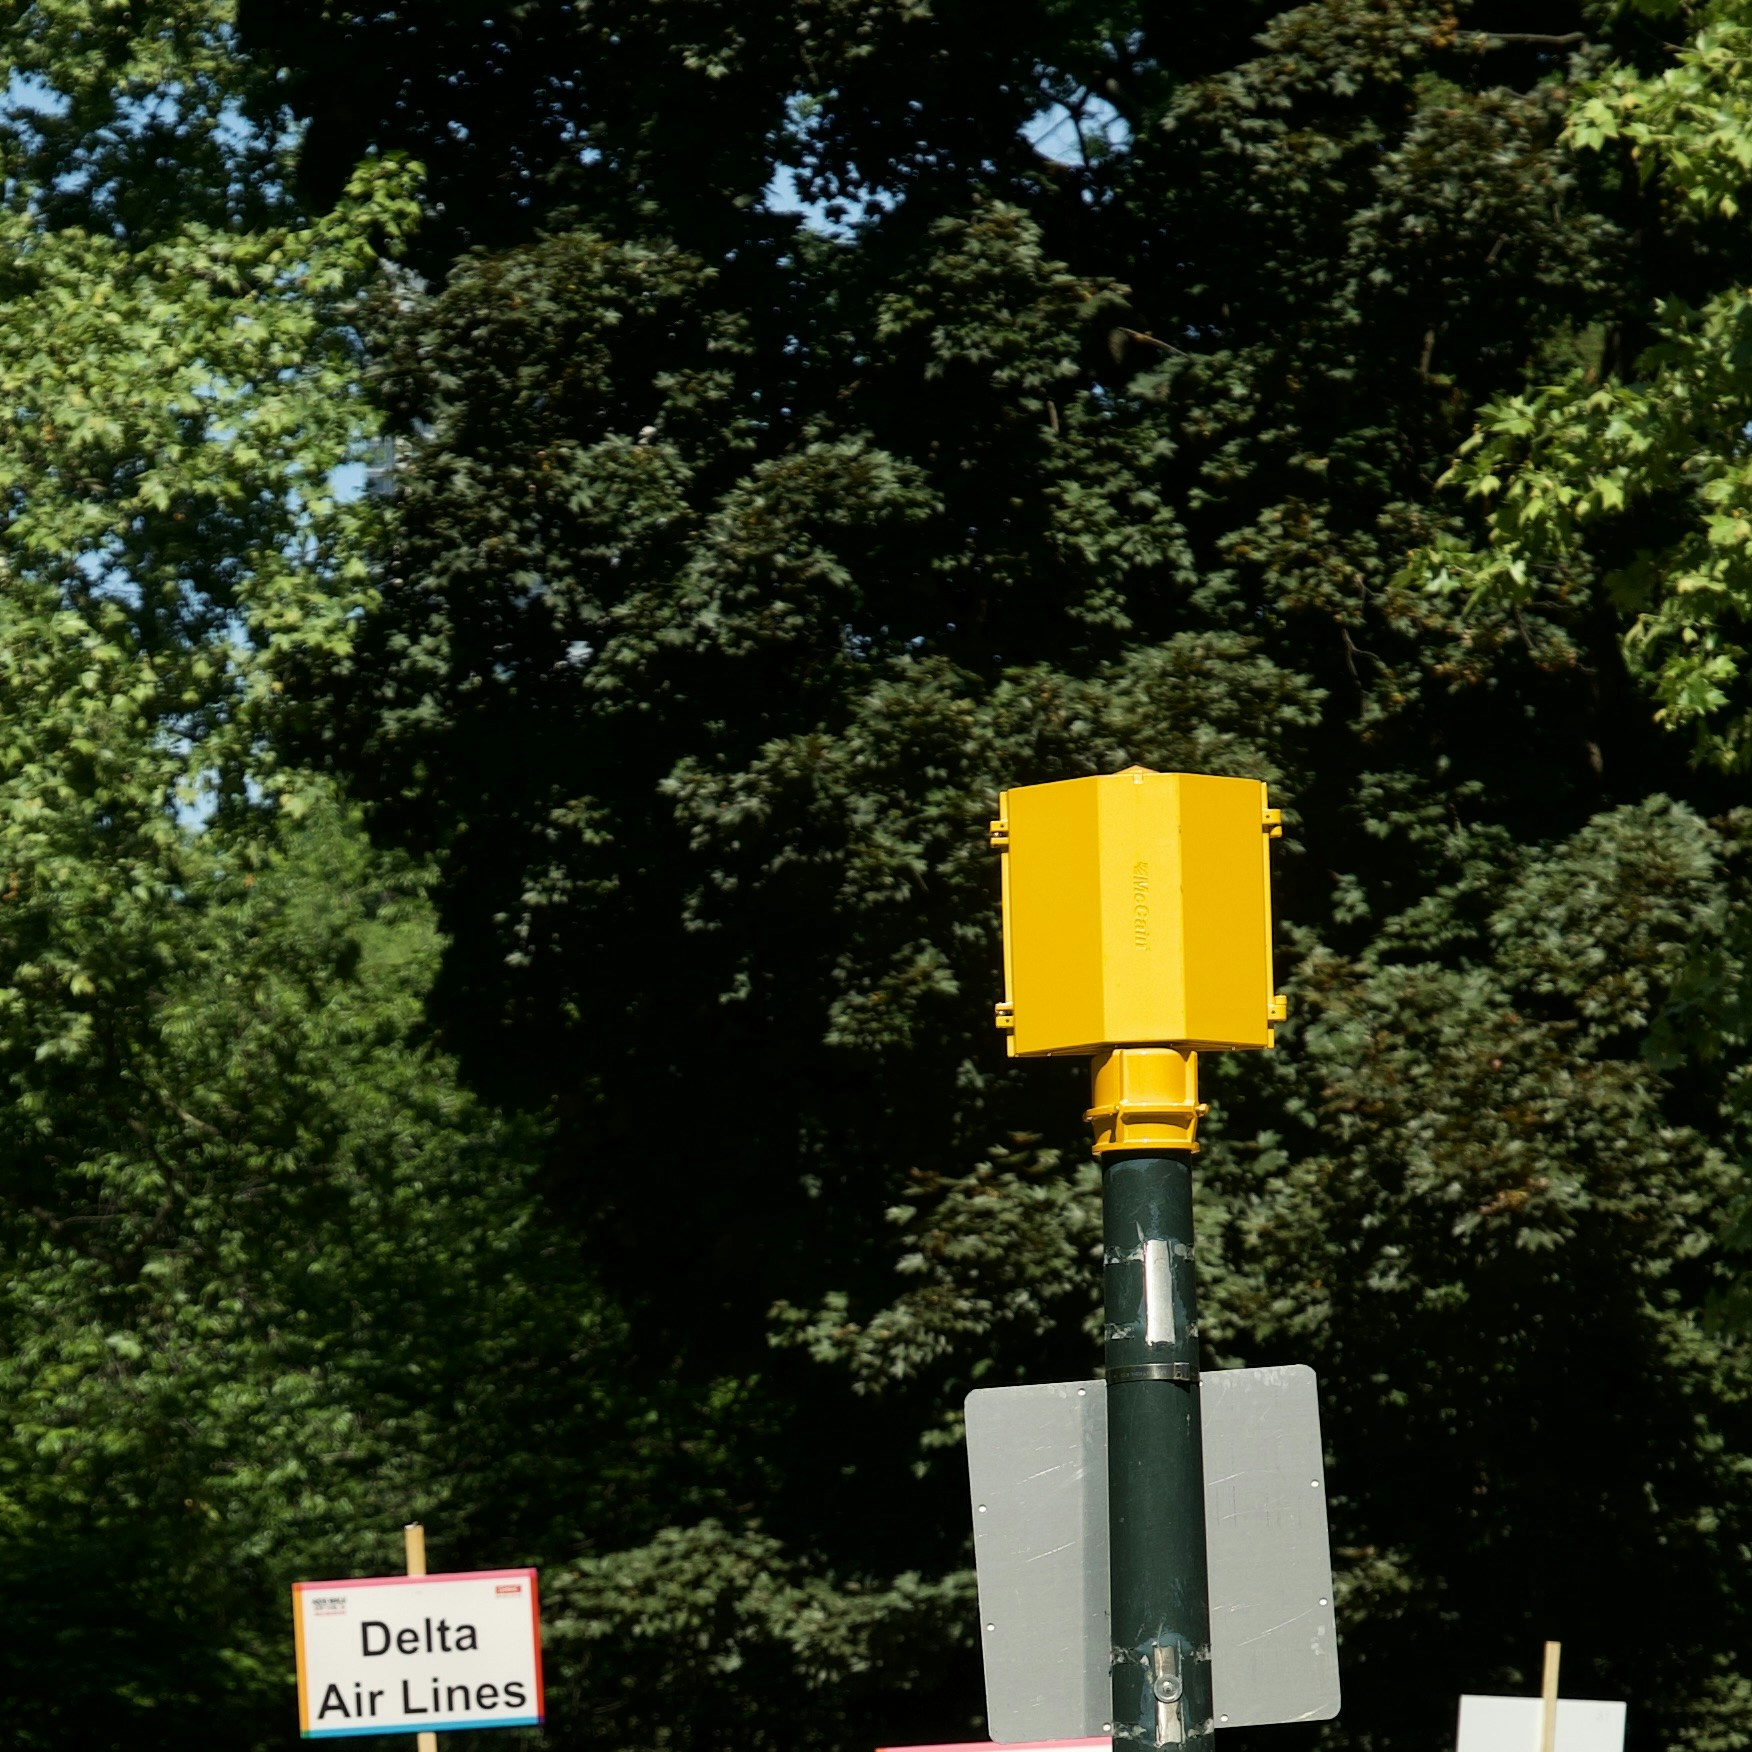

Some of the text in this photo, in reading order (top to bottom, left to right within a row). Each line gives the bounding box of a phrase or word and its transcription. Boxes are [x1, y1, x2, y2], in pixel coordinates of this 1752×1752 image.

[361, 1616, 478, 1657] Delta
[318, 1676, 527, 1719] Air Lines
